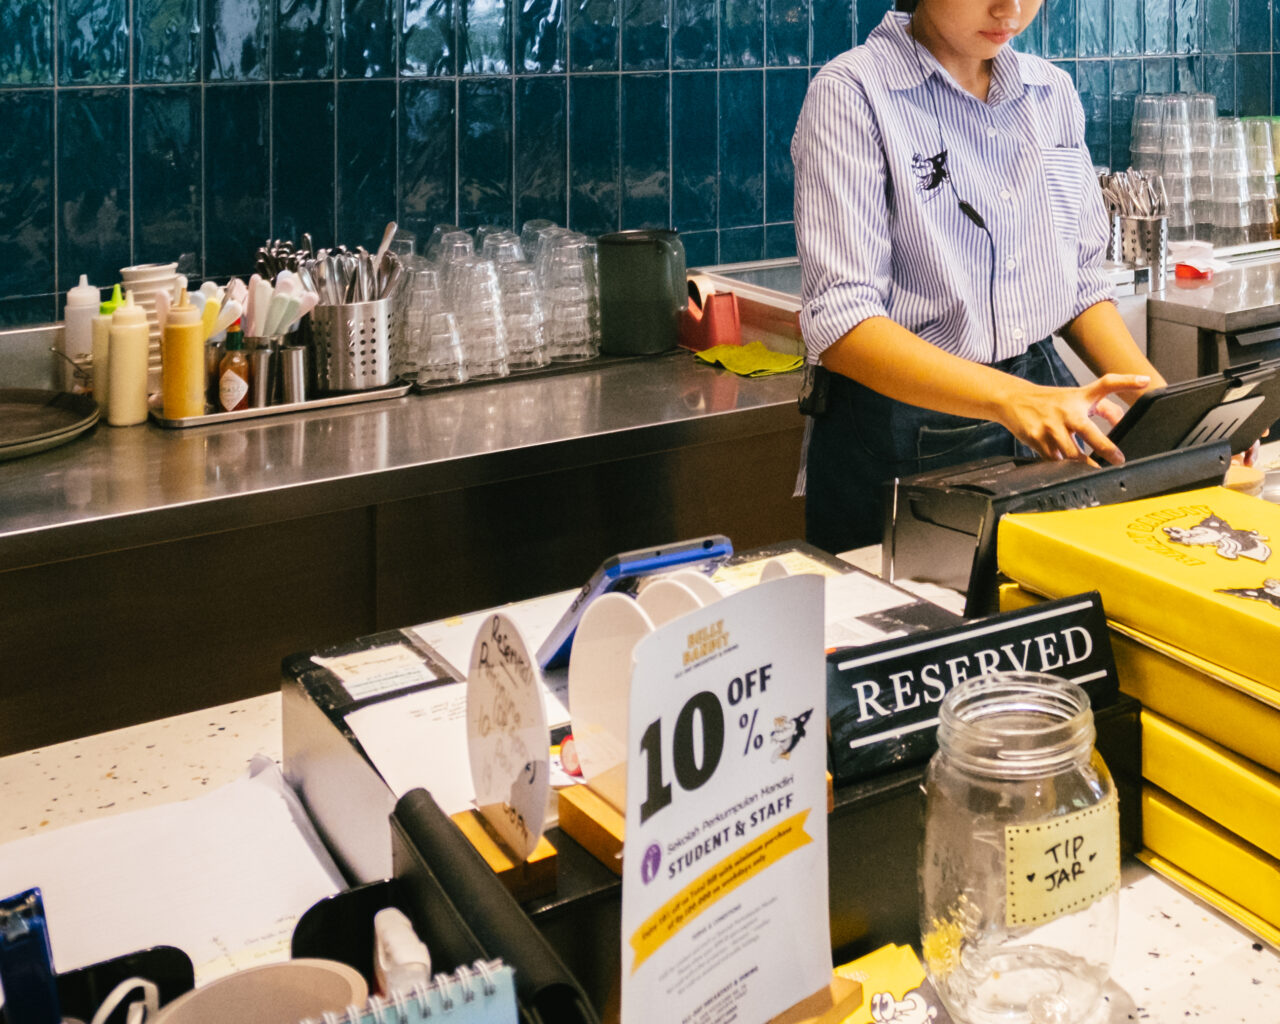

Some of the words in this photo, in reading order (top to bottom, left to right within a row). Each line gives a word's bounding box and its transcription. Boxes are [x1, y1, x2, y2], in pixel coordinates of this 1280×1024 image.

[852, 626, 1093, 723] RESERVED
[640, 690, 725, 826] 10
[727, 663, 773, 706] OFF
[760, 774, 795, 798] Mandiri
[668, 827, 731, 879] STUDENT
[734, 820, 746, 837] &
[750, 792, 795, 827] STAFF
[764, 826, 793, 850] purchase
[1044, 835, 1084, 863] TIP
[752, 854, 767, 868] only
[1044, 861, 1085, 892] JAR
